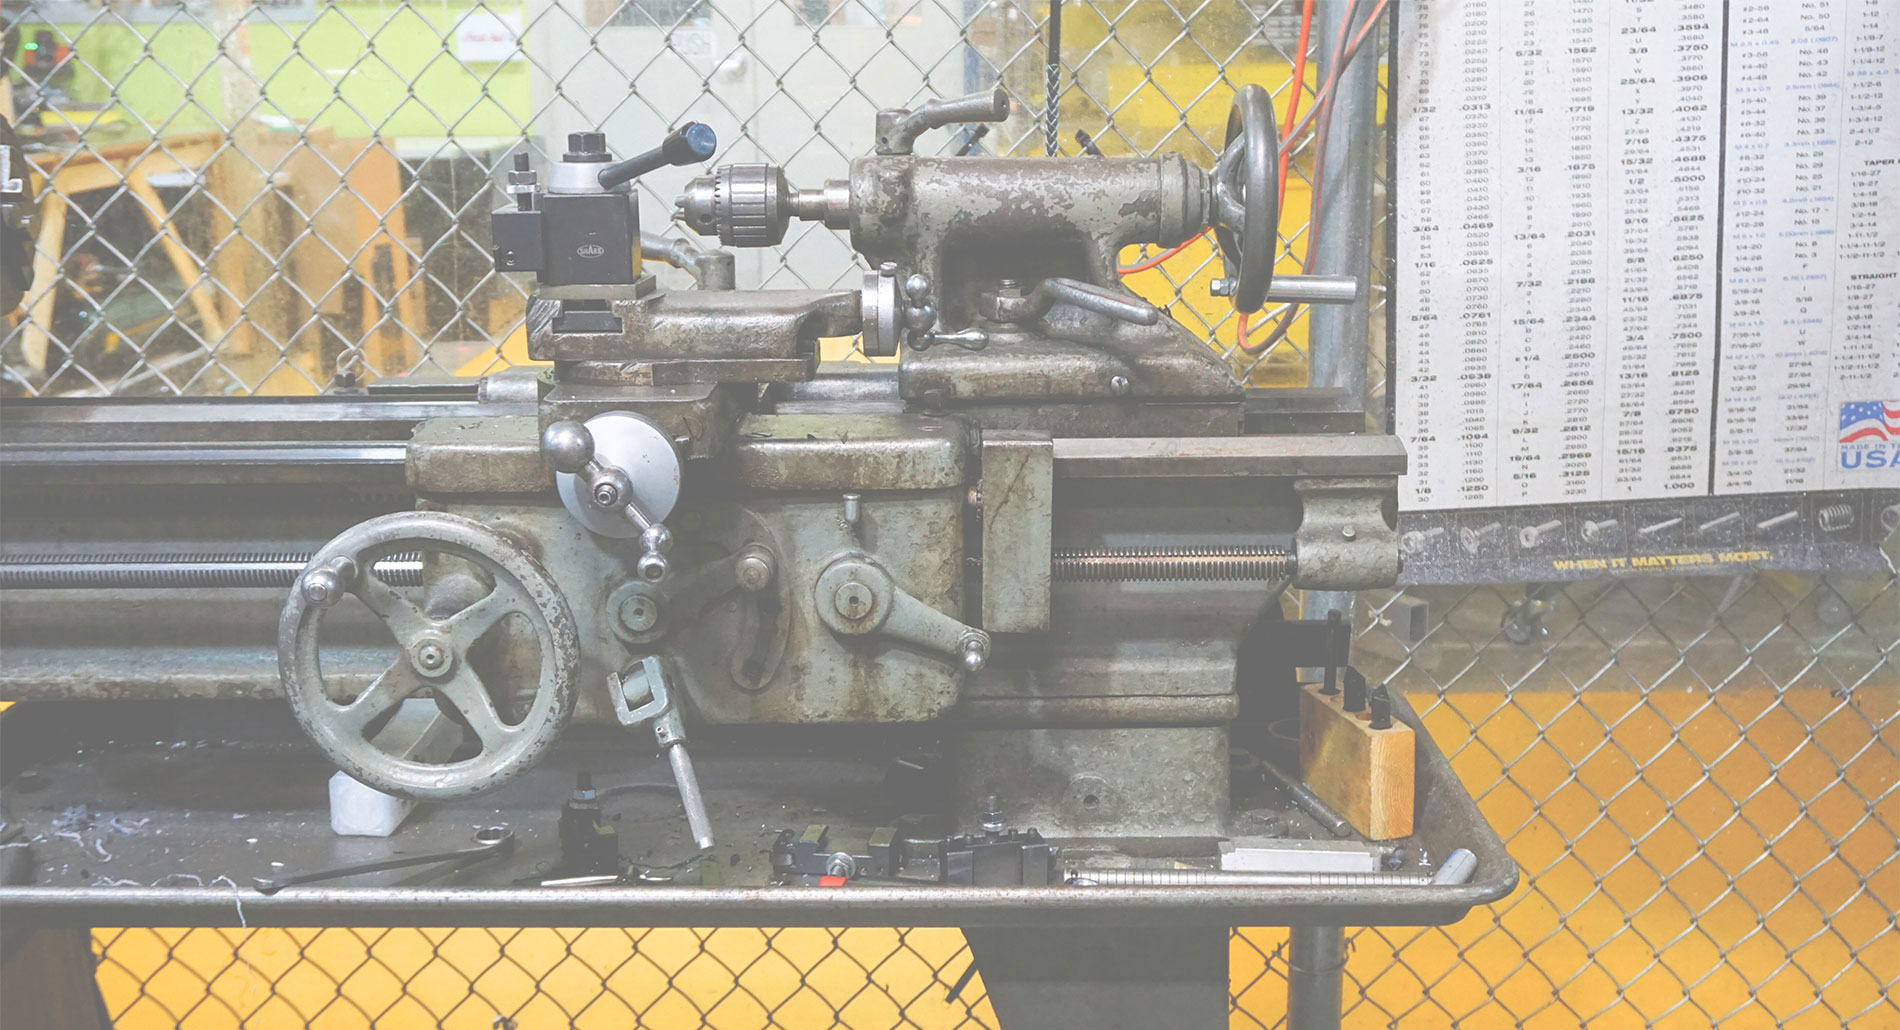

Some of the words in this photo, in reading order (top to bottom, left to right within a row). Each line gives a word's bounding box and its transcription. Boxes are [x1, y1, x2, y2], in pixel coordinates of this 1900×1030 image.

[1621, 26, 1657, 35] 23/64
[1674, 23, 1710, 32] .3594
[1516, 49, 1543, 57] 5/32
[1565, 46, 1597, 55] .1562
[1629, 47, 1649, 55] 3/8
[1674, 44, 1709, 52] .3750
[1620, 77, 1656, 86] 25/64
[1673, 74, 1708, 83] .3906
[1412, 106, 1437, 114] 1/32
[1459, 103, 1492, 112] .0313
[1514, 108, 1544, 116] 11/64
[1622, 107, 1654, 116] 13/32
[1672, 104, 1708, 113] .4062
[1625, 138, 1650, 146] 7/16
[1672, 135, 1707, 143] .4375
[1621, 158, 1654, 166] 15/32
[1518, 166, 1542, 175] 3/16
[1628, 178, 1645, 186] 1/2
[1670, 174, 1706, 184] .5000
[1460, 222, 1494, 230] .0469
[1514, 233, 1546, 241] 13/64
[1565, 230, 1596, 238] .2031
[1415, 261, 1437, 269] 1/16
[1460, 258, 1494, 266] .0625
[1670, 254, 1705, 262] .6250
[1516, 280, 1543, 288] 7/32
[1411, 314, 1438, 322] 5/64
[1513, 318, 1545, 326] 15/64
[1560, 314, 1597, 323] .2344
[1626, 334, 1645, 342] 3/4
[1669, 332, 1703, 340] .7500
[1522, 354, 1541, 362] 1/4
[1561, 351, 1596, 360] .2500
[1410, 375, 1438, 383] 3/32
[1619, 372, 1649, 380] 13/16
[1511, 382, 1543, 390] 17/64
[1623, 410, 1642, 418] 7/8
[1416, 487, 1432, 495] 1/8
[1457, 484, 1489, 492] .1250
[1664, 482, 1696, 490] 1.000
[1553, 560, 1606, 570] WHEN
[1612, 558, 1627, 568] IT
[1632, 554, 1714, 567] MATTERS
[1719, 550, 1773, 562] MOST.
